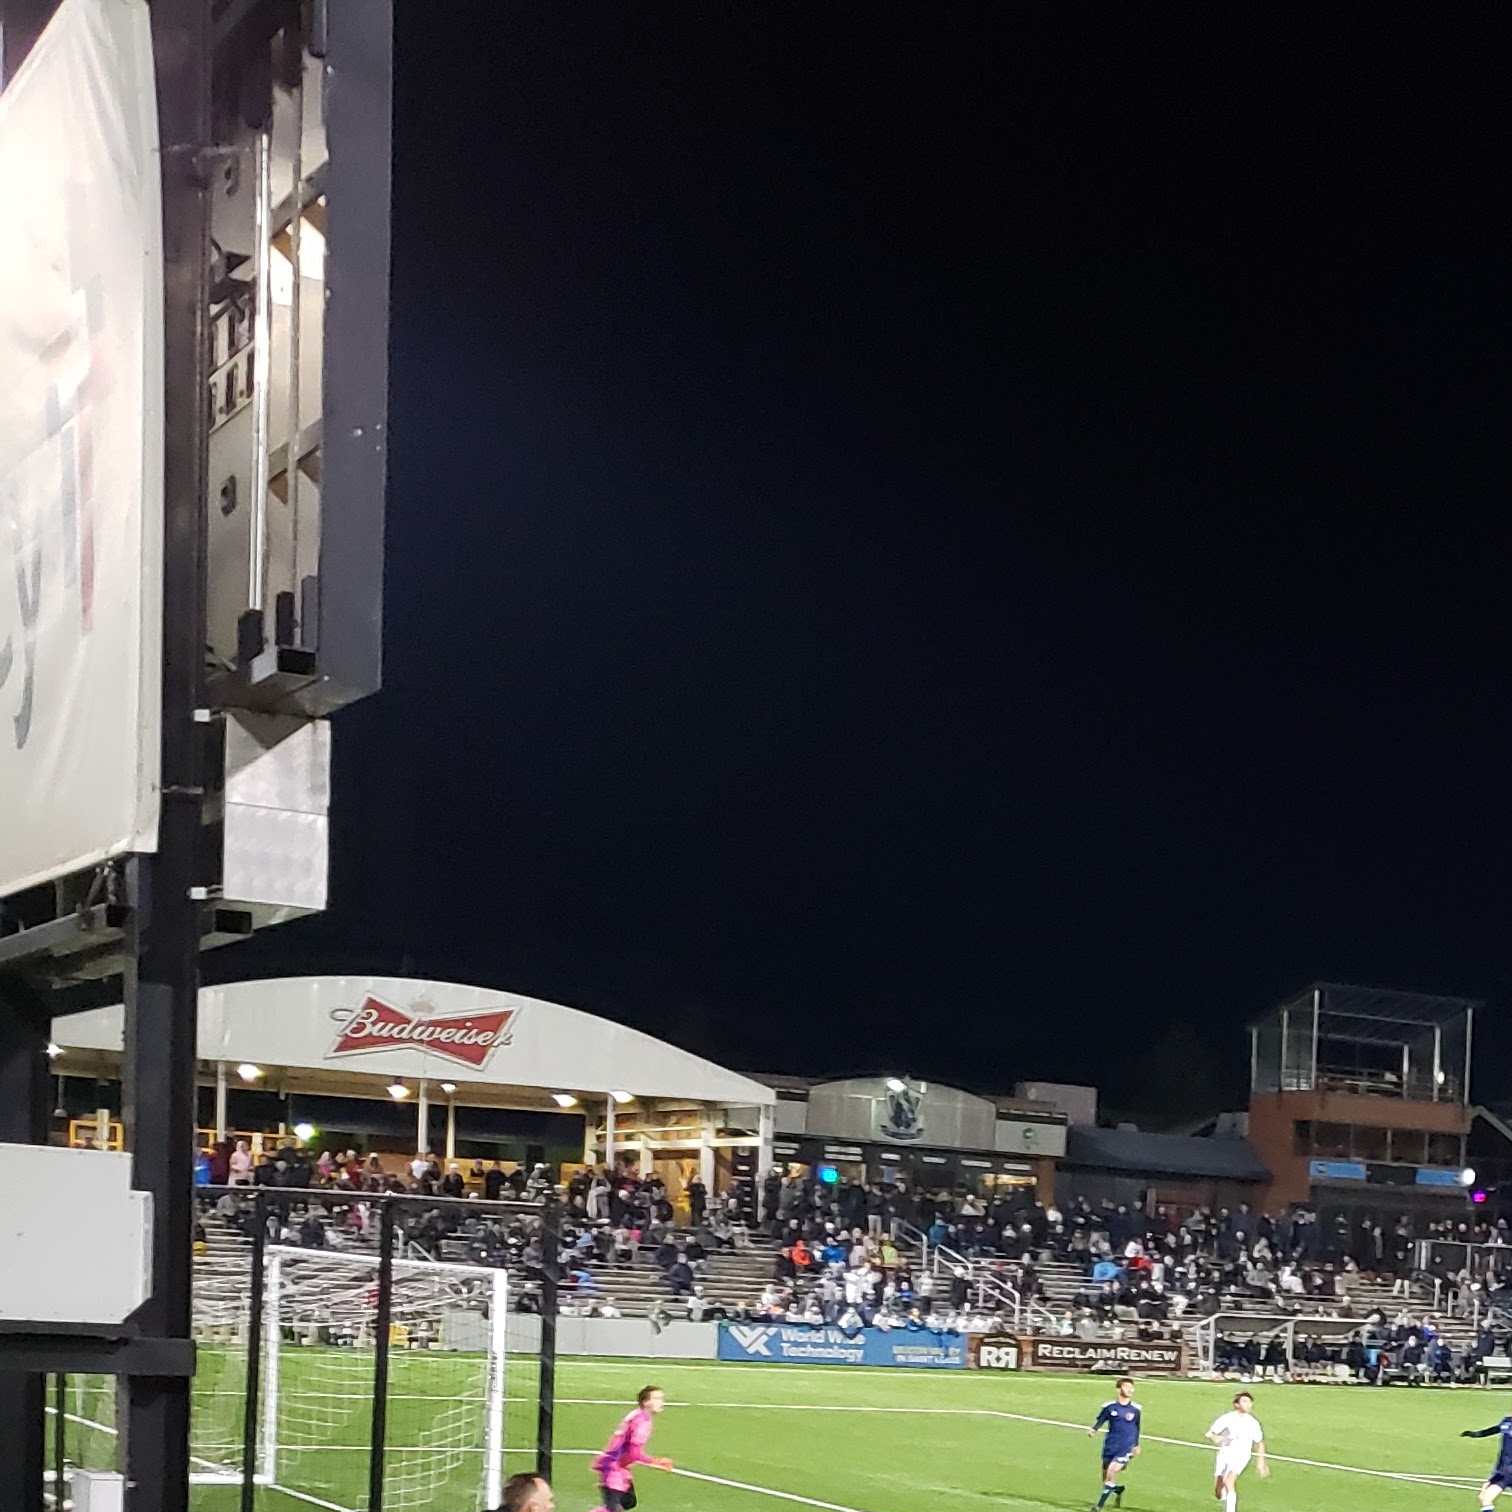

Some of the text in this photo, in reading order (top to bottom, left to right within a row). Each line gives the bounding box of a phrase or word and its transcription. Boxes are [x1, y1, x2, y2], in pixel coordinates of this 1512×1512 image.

[330, 1008, 513, 1047] Budweiser
[781, 1328, 826, 1343] World
[780, 1342, 865, 1362] Technology
